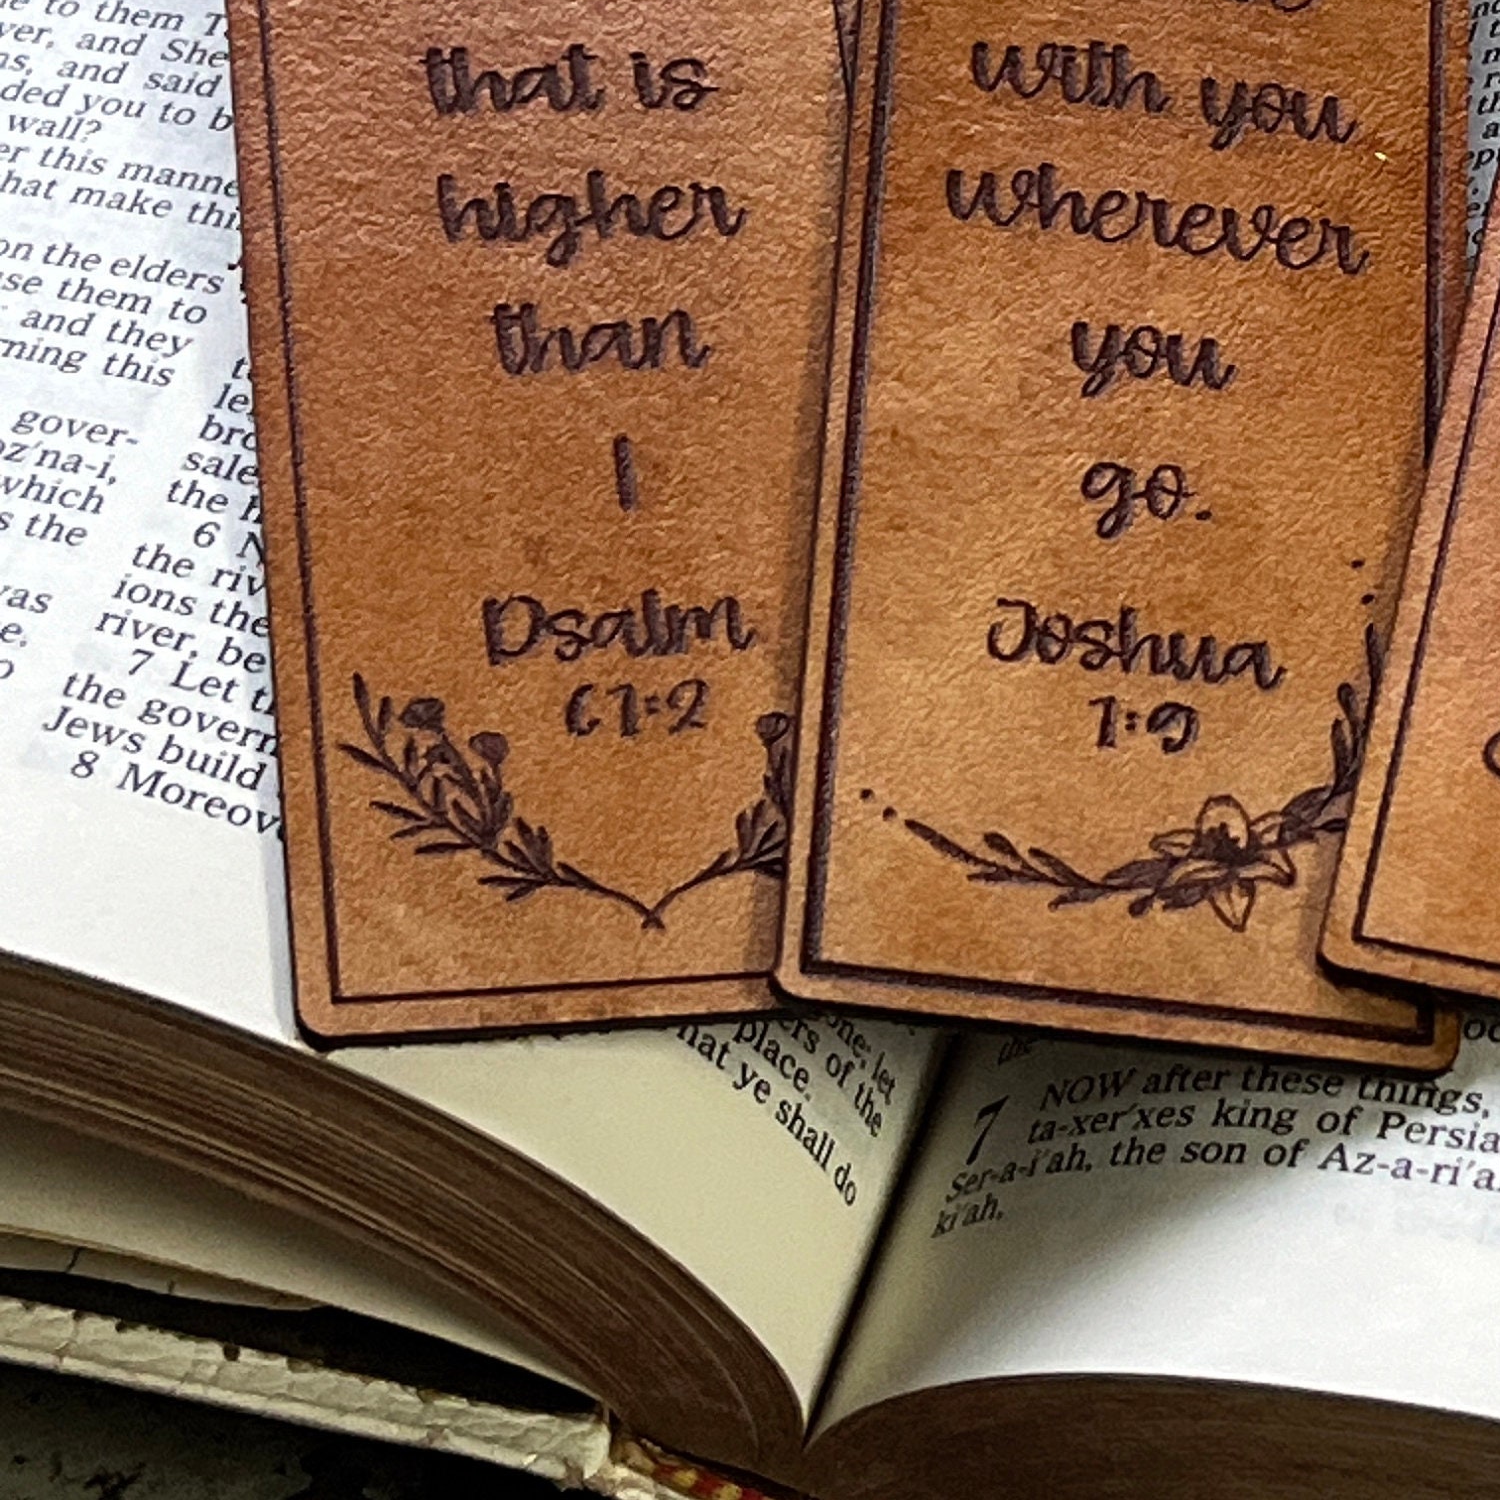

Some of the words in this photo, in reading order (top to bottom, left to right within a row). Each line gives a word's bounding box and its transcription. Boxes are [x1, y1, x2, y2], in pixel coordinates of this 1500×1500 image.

[419, 44, 606, 114] that
[632, 48, 718, 111] is
[971, 41, 1174, 115] with
[1200, 76, 1358, 150] you
[8, 114, 101, 143] wall?
[436, 170, 747, 267] higher
[945, 162, 1370, 276] wherever
[110, 255, 224, 295] elders
[102, 352, 175, 387] this
[489, 302, 710, 377] than
[1070, 320, 1237, 398] you
[1081, 461, 1212, 539] go.
[95, 608, 198, 658] river,
[481, 589, 755, 667] Psalm
[987, 596, 1287, 691] Joshua
[128, 648, 155, 676] 7
[170, 660, 239, 702] Let
[42, 705, 146, 754] Jews
[158, 734, 267, 791] build
[70, 750, 99, 779] 8
[732, 1062, 771, 1104] ye
[775, 1099, 835, 1172] shall
[834, 1163, 856, 1206] do
[966, 1096, 1009, 1165] 7
[1039, 1066, 1137, 1111] NOW
[1142, 1064, 1232, 1096] after
[1241, 1062, 1343, 1097] these
[1109, 1135, 1166, 1168] the
[1180, 1140, 1246, 1166] son
[1212, 1098, 1299, 1135] king
